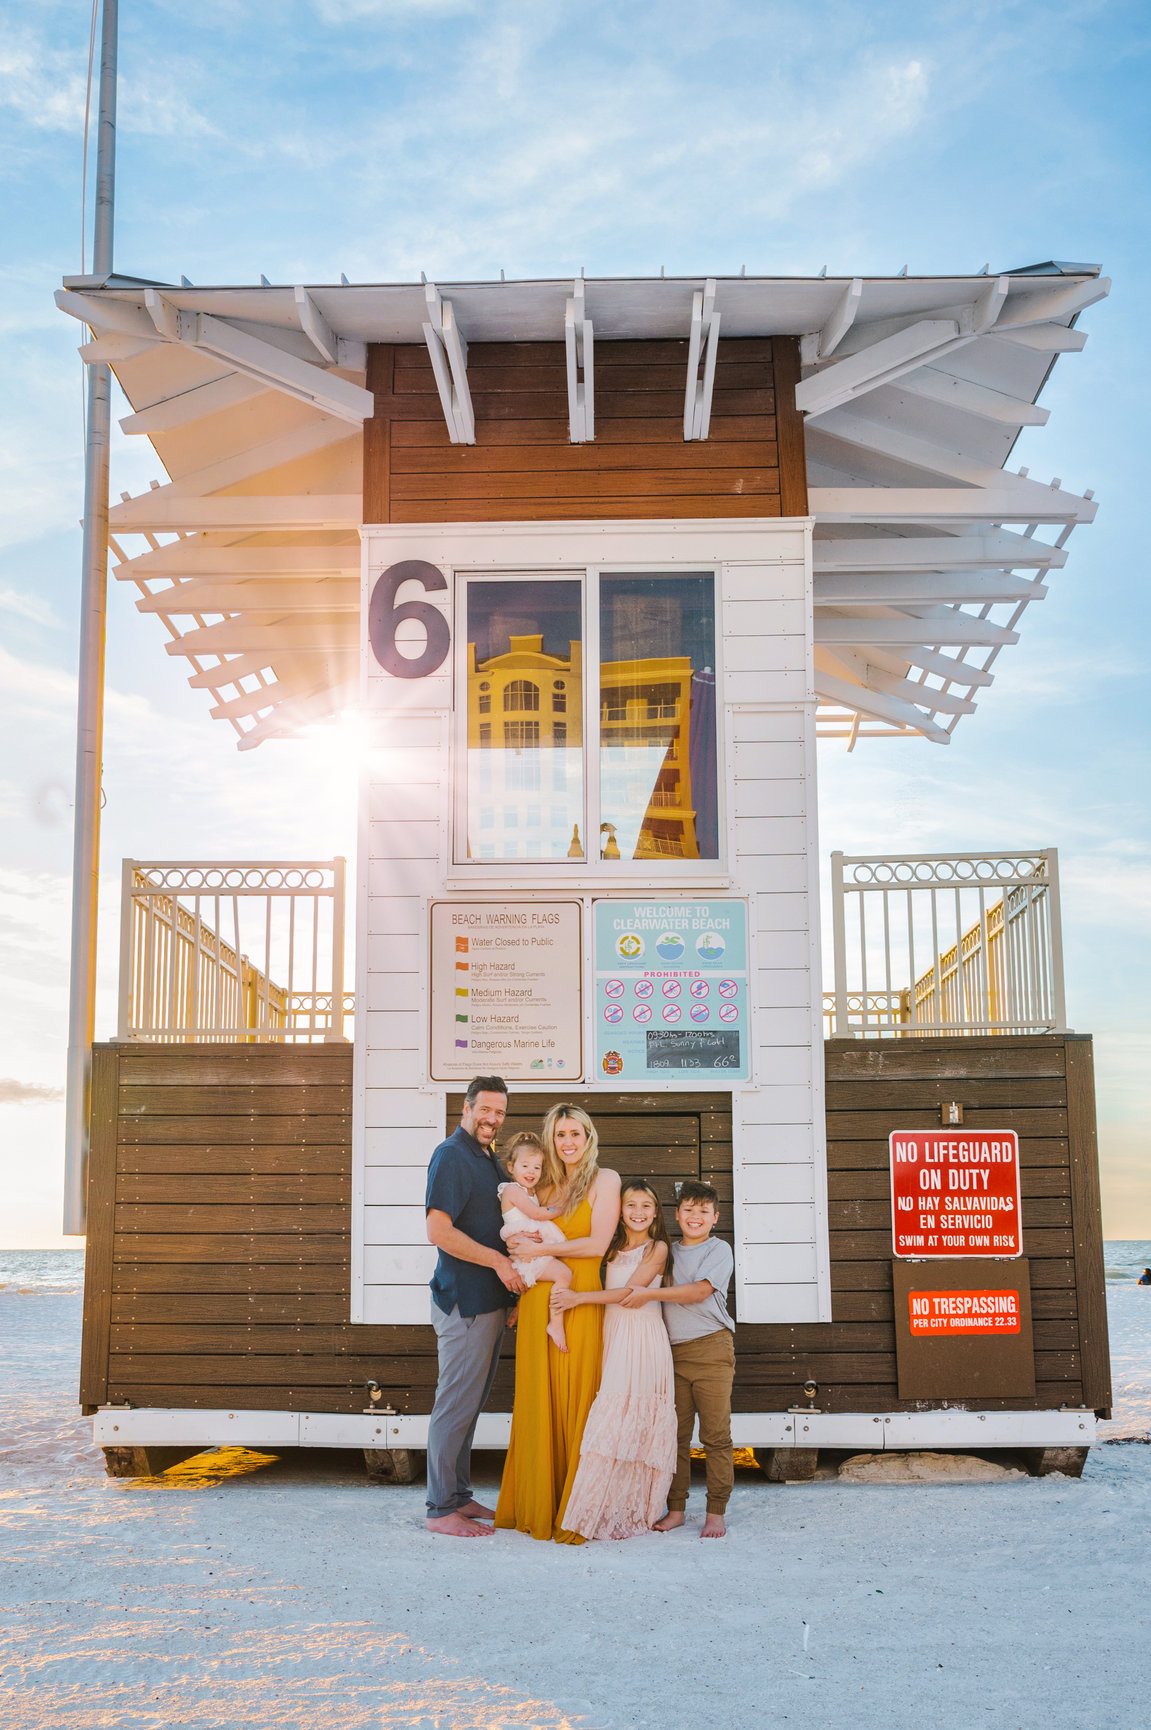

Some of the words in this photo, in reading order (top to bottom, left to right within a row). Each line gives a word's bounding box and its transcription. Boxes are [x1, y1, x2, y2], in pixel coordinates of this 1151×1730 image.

[368, 560, 450, 679] 6
[633, 906, 692, 918] WELCOME
[695, 906, 710, 917] TO
[452, 914, 482, 925] BEACH
[486, 913, 527, 924] WARNING
[531, 913, 560, 924] FLAGS
[613, 919, 689, 930] CLEARWATER
[692, 918, 730, 929] BEACH
[471, 938, 493, 946] Water
[494, 938, 520, 946] Closed
[522, 938, 529, 946] to
[531, 937, 554, 946] Public
[471, 963, 487, 972] High
[489, 962, 515, 970] Hazard
[471, 988, 502, 997] Medium
[504, 988, 532, 996] Hazard
[471, 1014, 487, 1023] Low
[490, 1014, 519, 1023] Hazard
[471, 1039, 512, 1050] Dangerous
[513, 1040, 539, 1048] Marine
[541, 1039, 555, 1047] Life
[670, 1039, 696, 1049] Sunny
[896, 1142, 918, 1163] NO
[924, 1141, 1013, 1163] LIFEGUARD
[919, 1169, 942, 1190] ON
[948, 1169, 990, 1190] DUTY
[898, 1196, 913, 1211] NO
[918, 1196, 940, 1210] HAY
[945, 1196, 1014, 1211] SALVAVIDAS
[920, 1214, 935, 1229] EN
[940, 1214, 993, 1229] SERVICIO
[899, 1235, 925, 1247] SWIM
[927, 1235, 938, 1246] AT
[942, 1235, 965, 1247] YOUR
[969, 1235, 990, 1246] OWN
[993, 1235, 1015, 1247] RISK
[912, 1298, 929, 1315] NO
[932, 1296, 1017, 1315] TRESPASSING
[913, 1318, 929, 1328] PER
[930, 1318, 948, 1328] CITY
[949, 1317, 993, 1327] ORDINANCE
[994, 1316, 1017, 1326] 22.33
